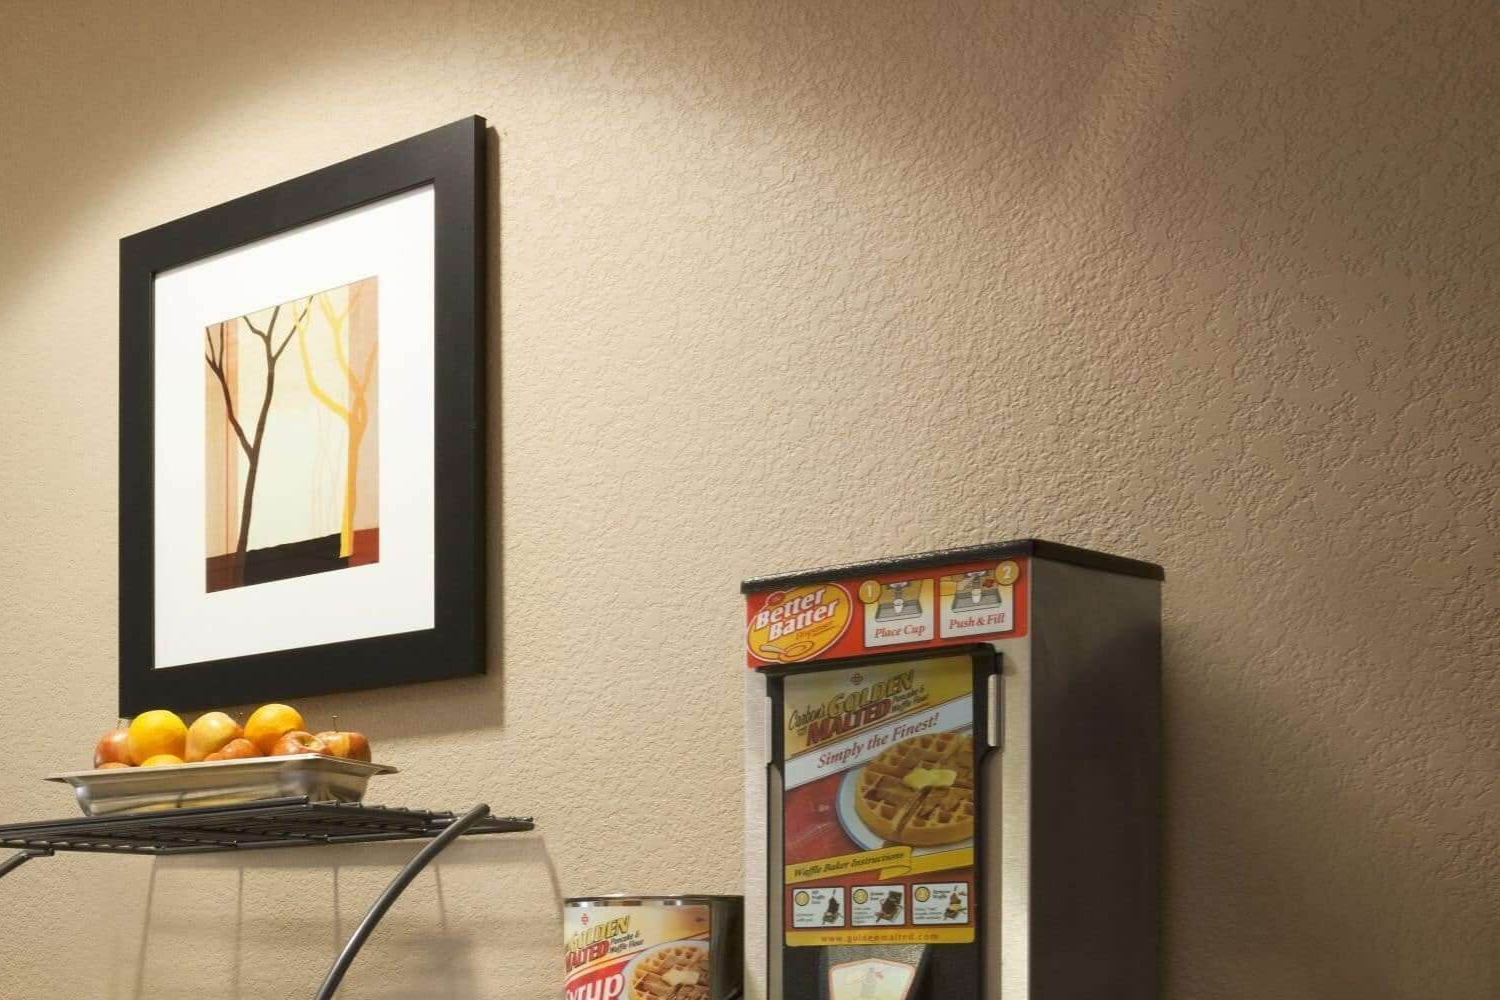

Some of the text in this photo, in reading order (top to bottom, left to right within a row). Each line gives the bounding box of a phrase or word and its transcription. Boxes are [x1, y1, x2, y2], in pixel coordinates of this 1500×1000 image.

[755, 586, 828, 630] Better
[768, 599, 840, 642] Batter
[948, 616, 975, 630] Push
[986, 613, 1005, 625] Fill
[874, 624, 926, 639] Place Cup
[806, 698, 892, 747] MALTED
[816, 711, 941, 769] Simply the Finest!
